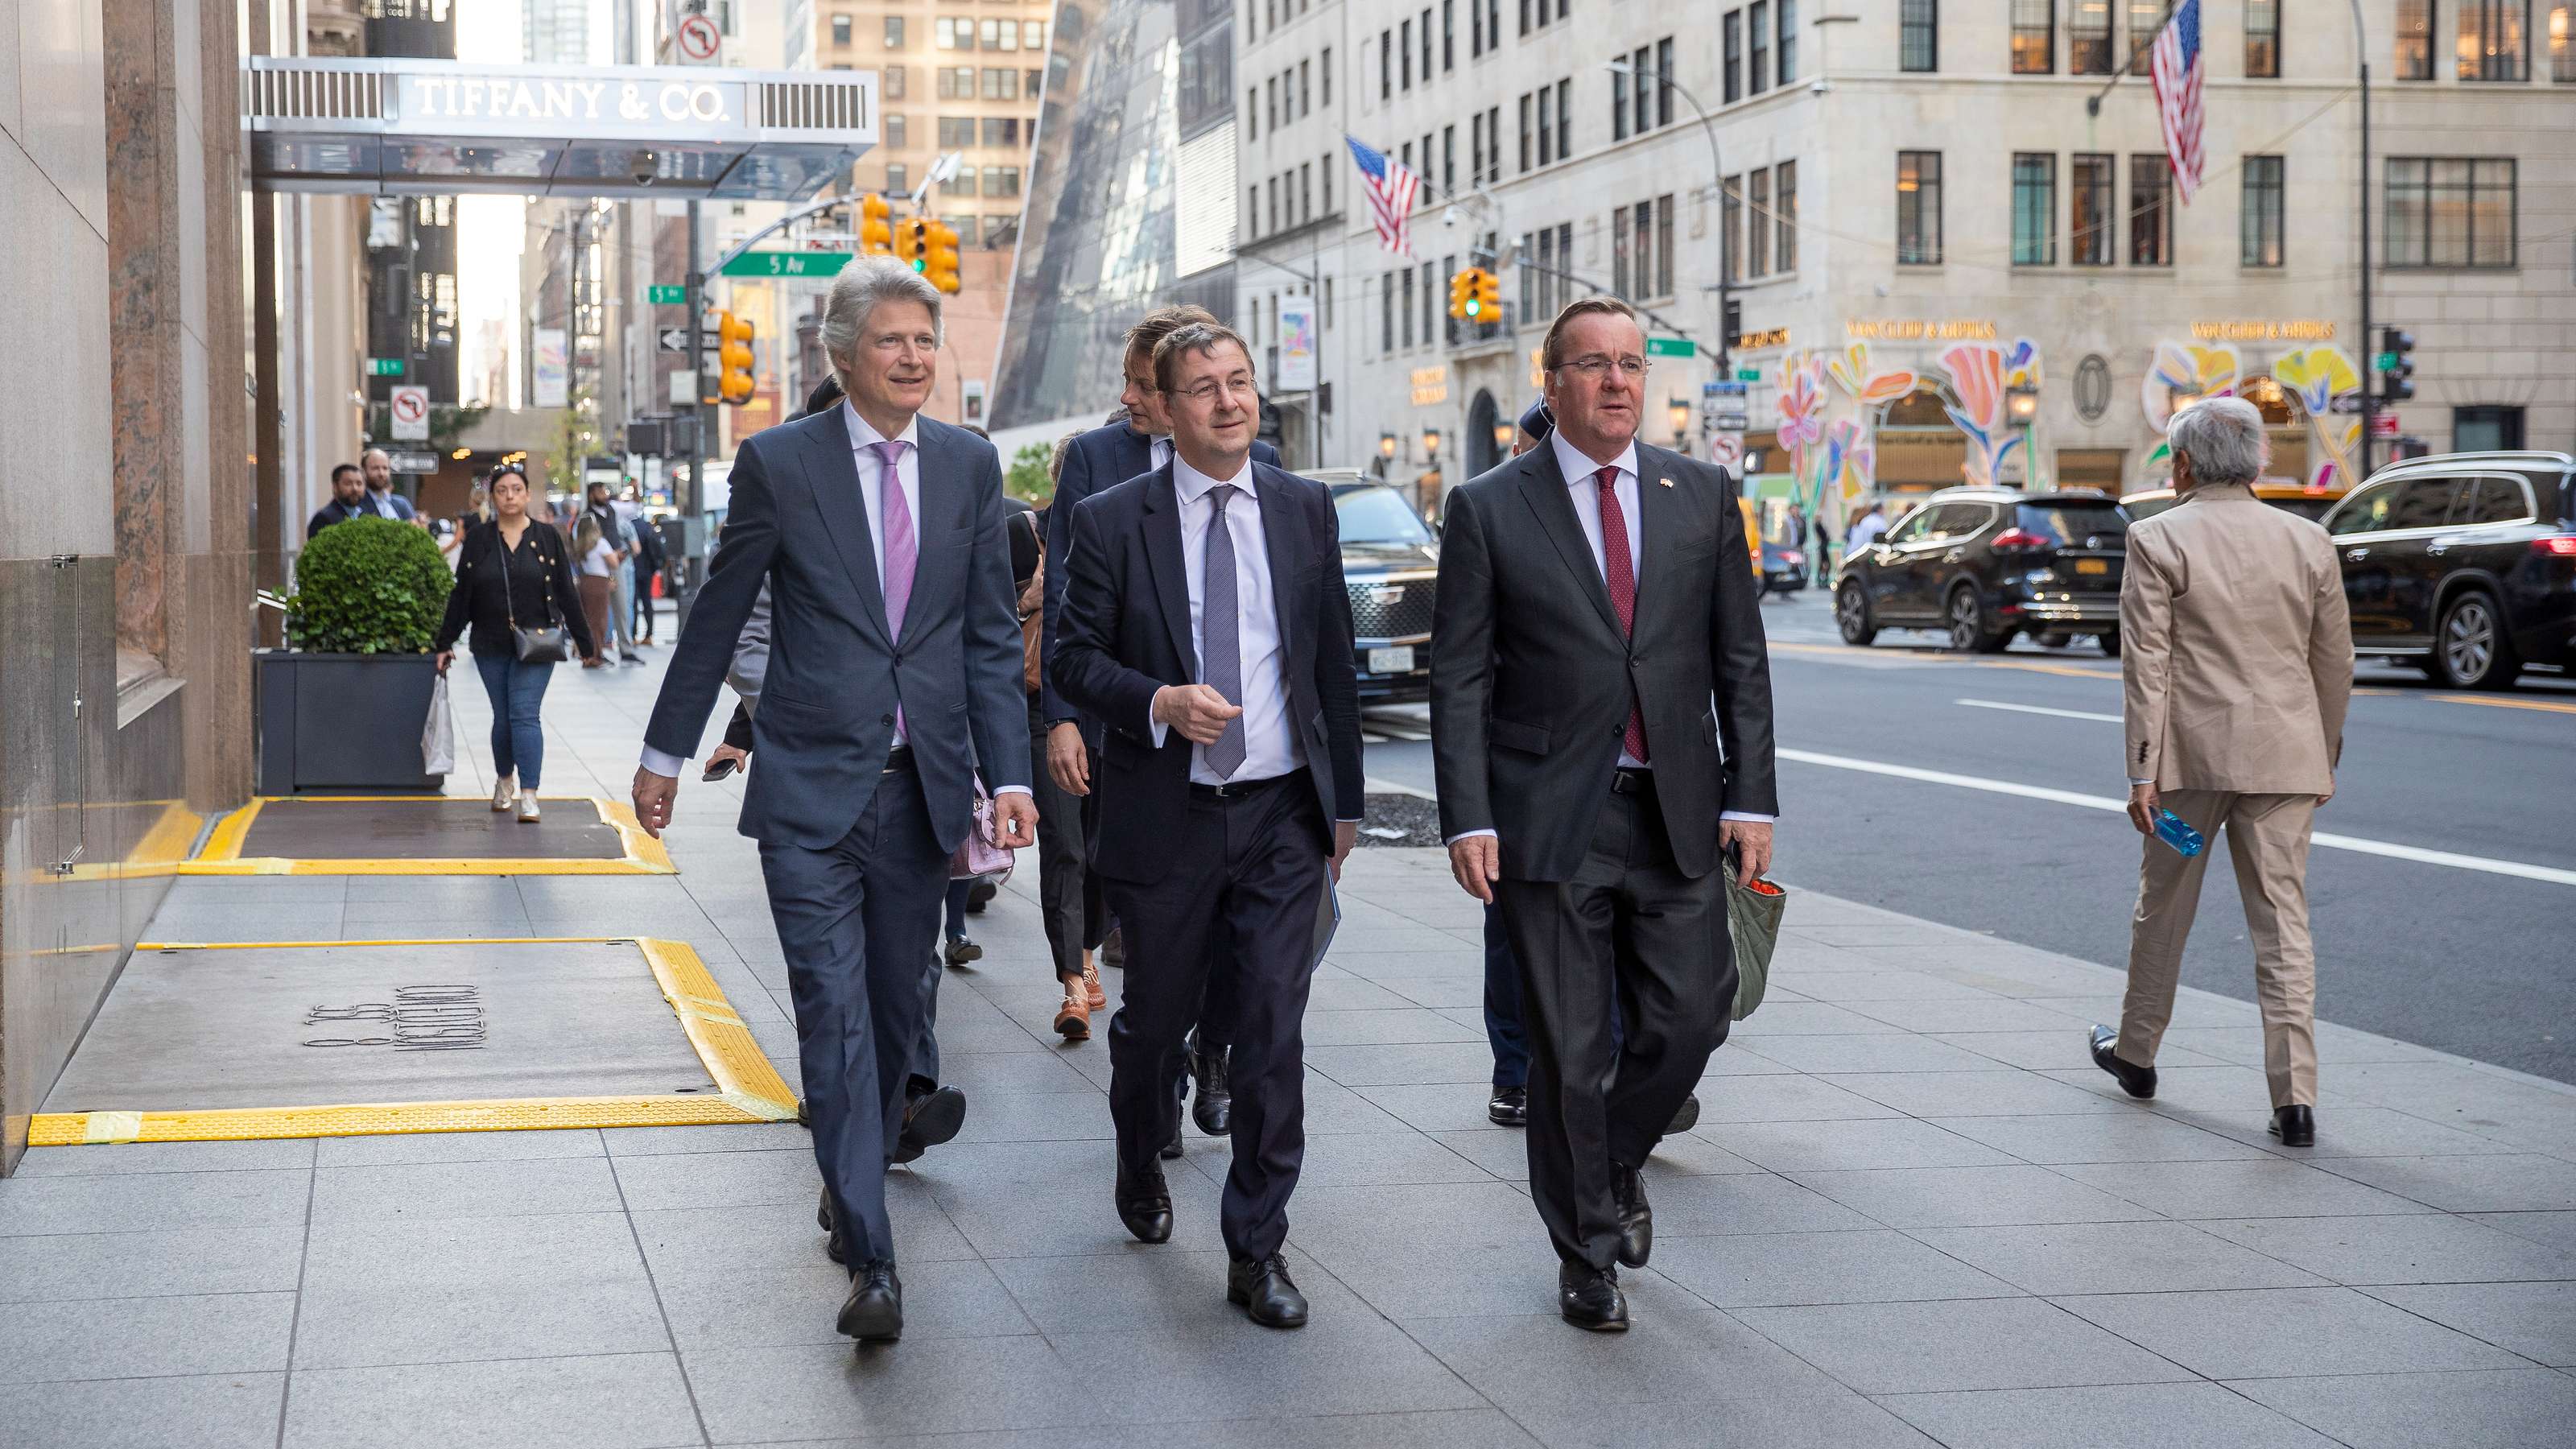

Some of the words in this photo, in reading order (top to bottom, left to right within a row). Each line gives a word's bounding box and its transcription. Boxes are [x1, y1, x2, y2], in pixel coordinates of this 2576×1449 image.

[414, 79, 605, 118] TIFFANY
[619, 83, 649, 119] &
[659, 84, 730, 122] CO.
[770, 256, 781, 275] 5
[786, 258, 806, 274] Av
[393, 1006, 488, 1052] EDISON
